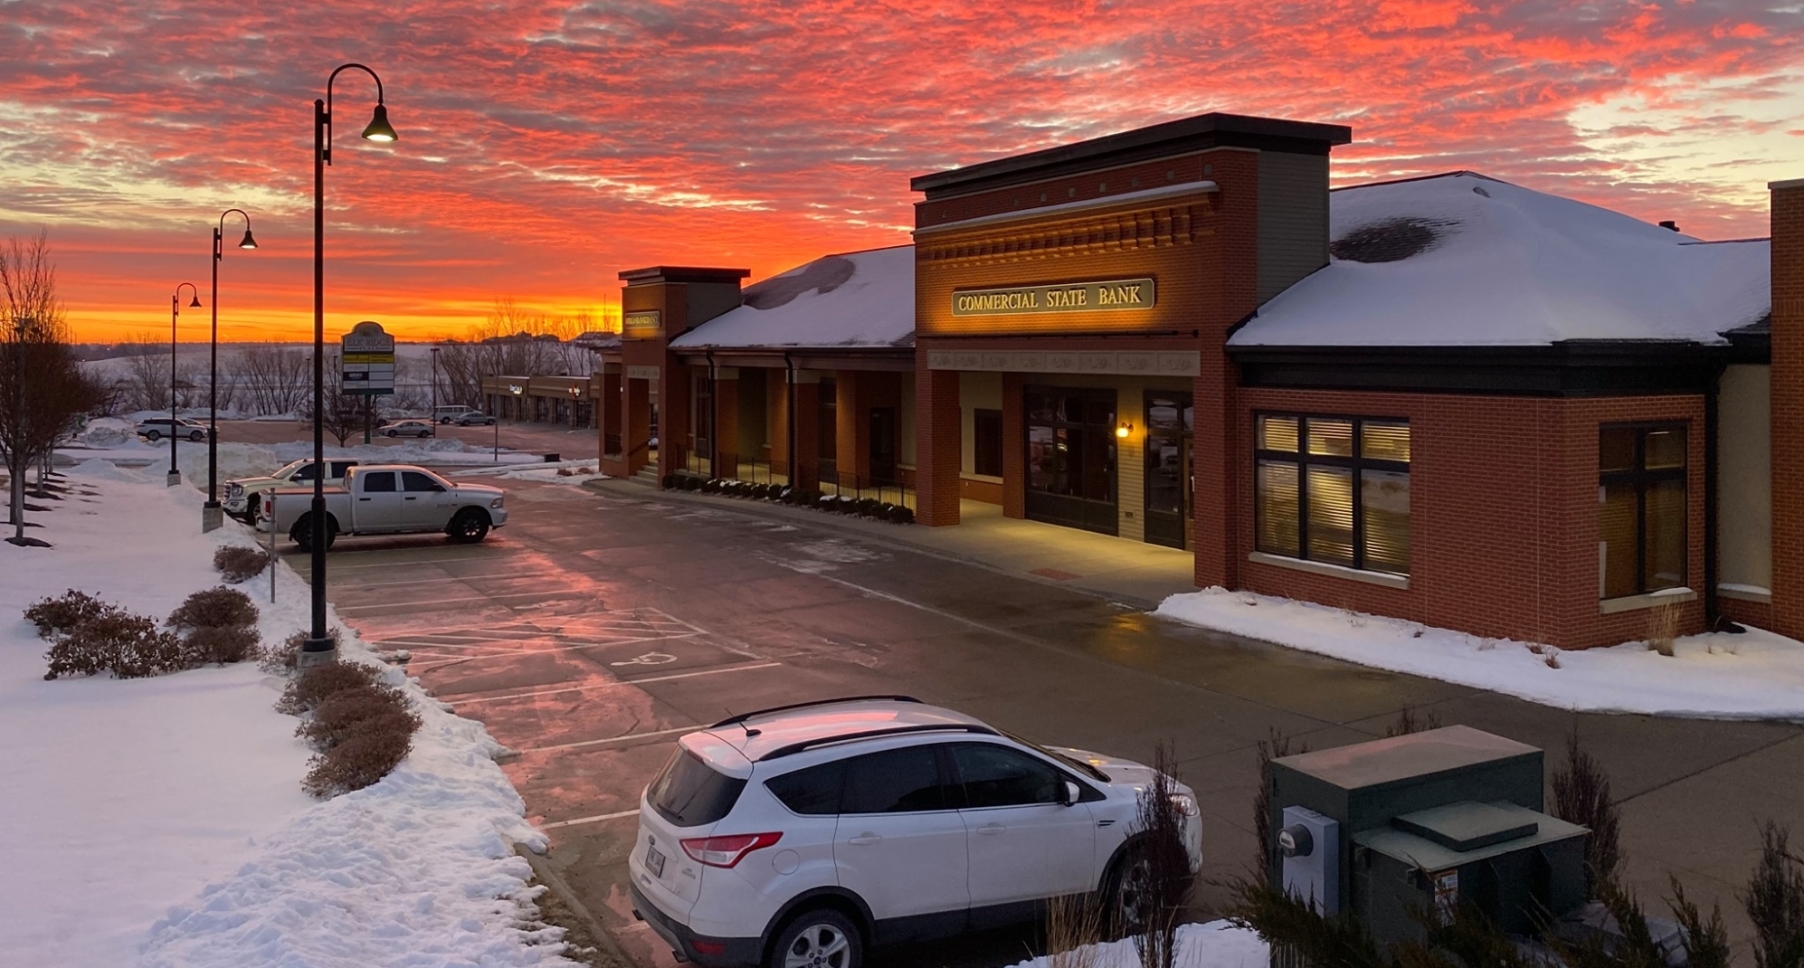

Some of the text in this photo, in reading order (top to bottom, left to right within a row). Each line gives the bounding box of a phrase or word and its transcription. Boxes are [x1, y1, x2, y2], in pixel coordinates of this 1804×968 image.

[958, 286, 1141, 311] COMMERCIAL STATE BANK
[347, 338, 391, 346] ELK RIDGE
